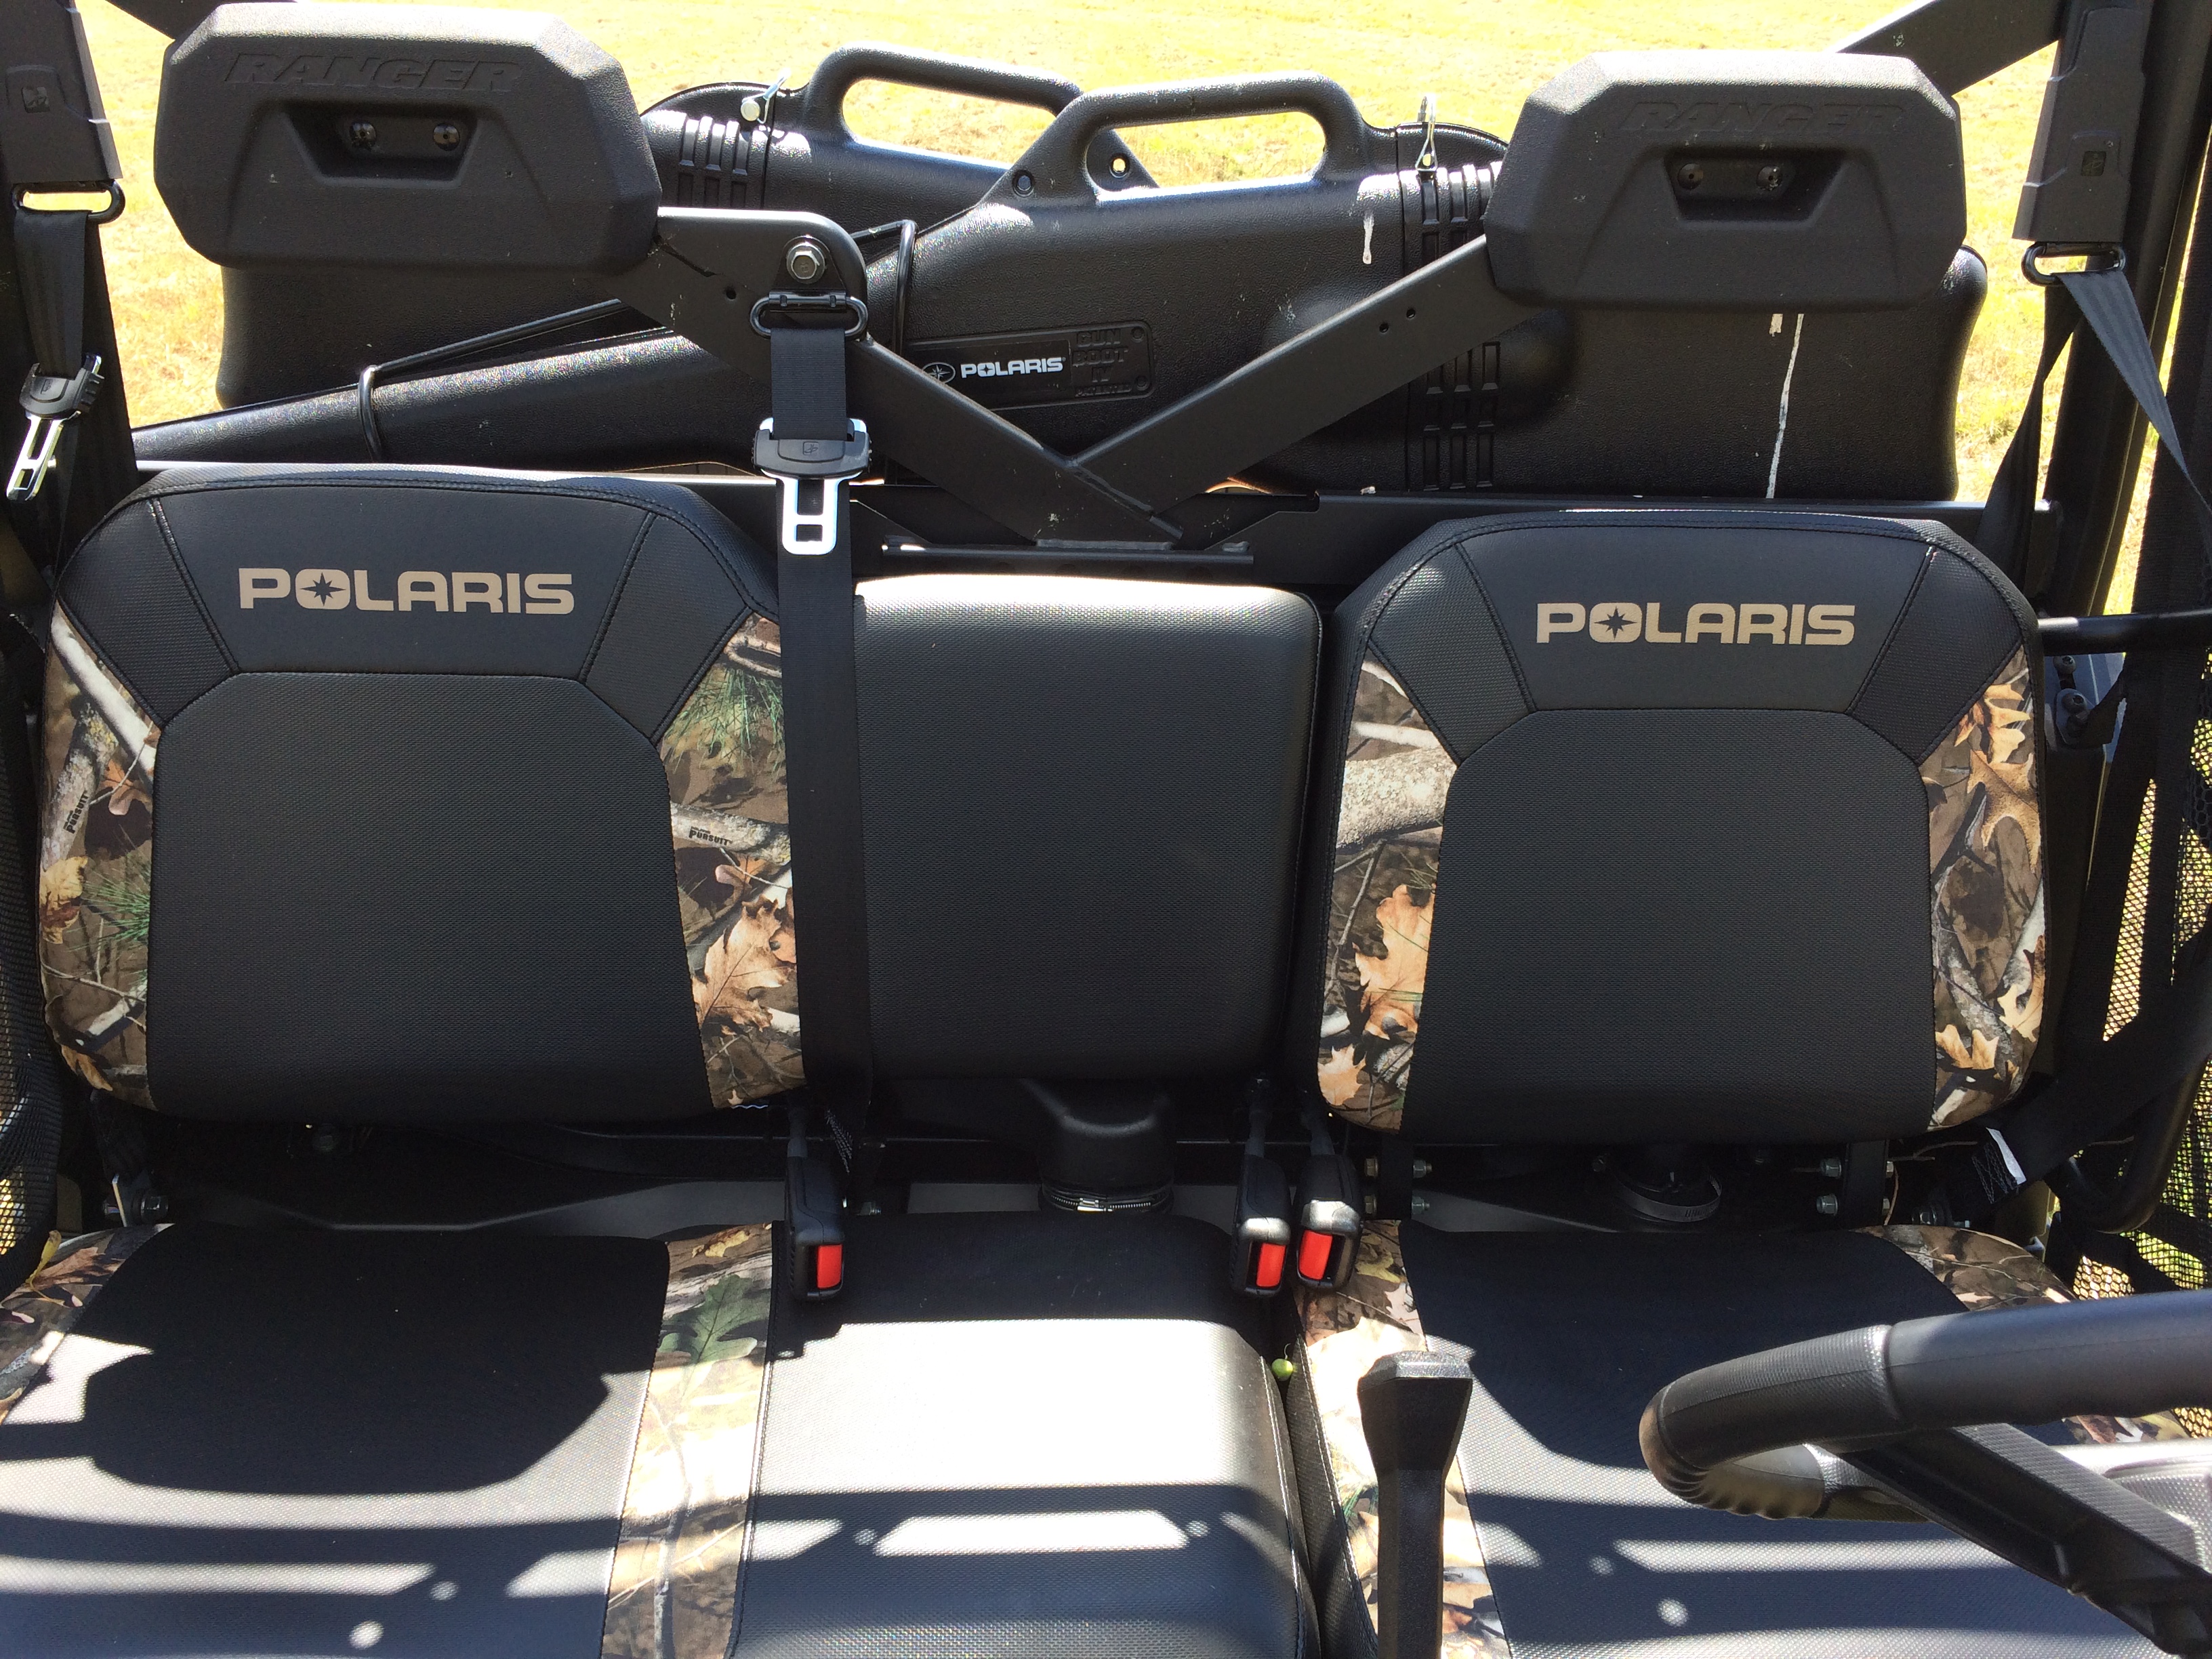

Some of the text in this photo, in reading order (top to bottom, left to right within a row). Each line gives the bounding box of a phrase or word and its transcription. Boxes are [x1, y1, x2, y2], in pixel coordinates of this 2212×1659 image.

[224, 53, 521, 91] RANGER
[1618, 102, 1904, 133] RANGER
[1076, 329, 1121, 347] GUN
[960, 357, 1063, 378] POLARIS
[1072, 347, 1128, 367] BOOT
[1092, 367, 1111, 383] IV
[239, 568, 574, 615] POLARIS
[1536, 602, 1856, 645] POLARIS
[66, 794, 88, 834] PURSUIT
[689, 830, 730, 845] PURSUIT
